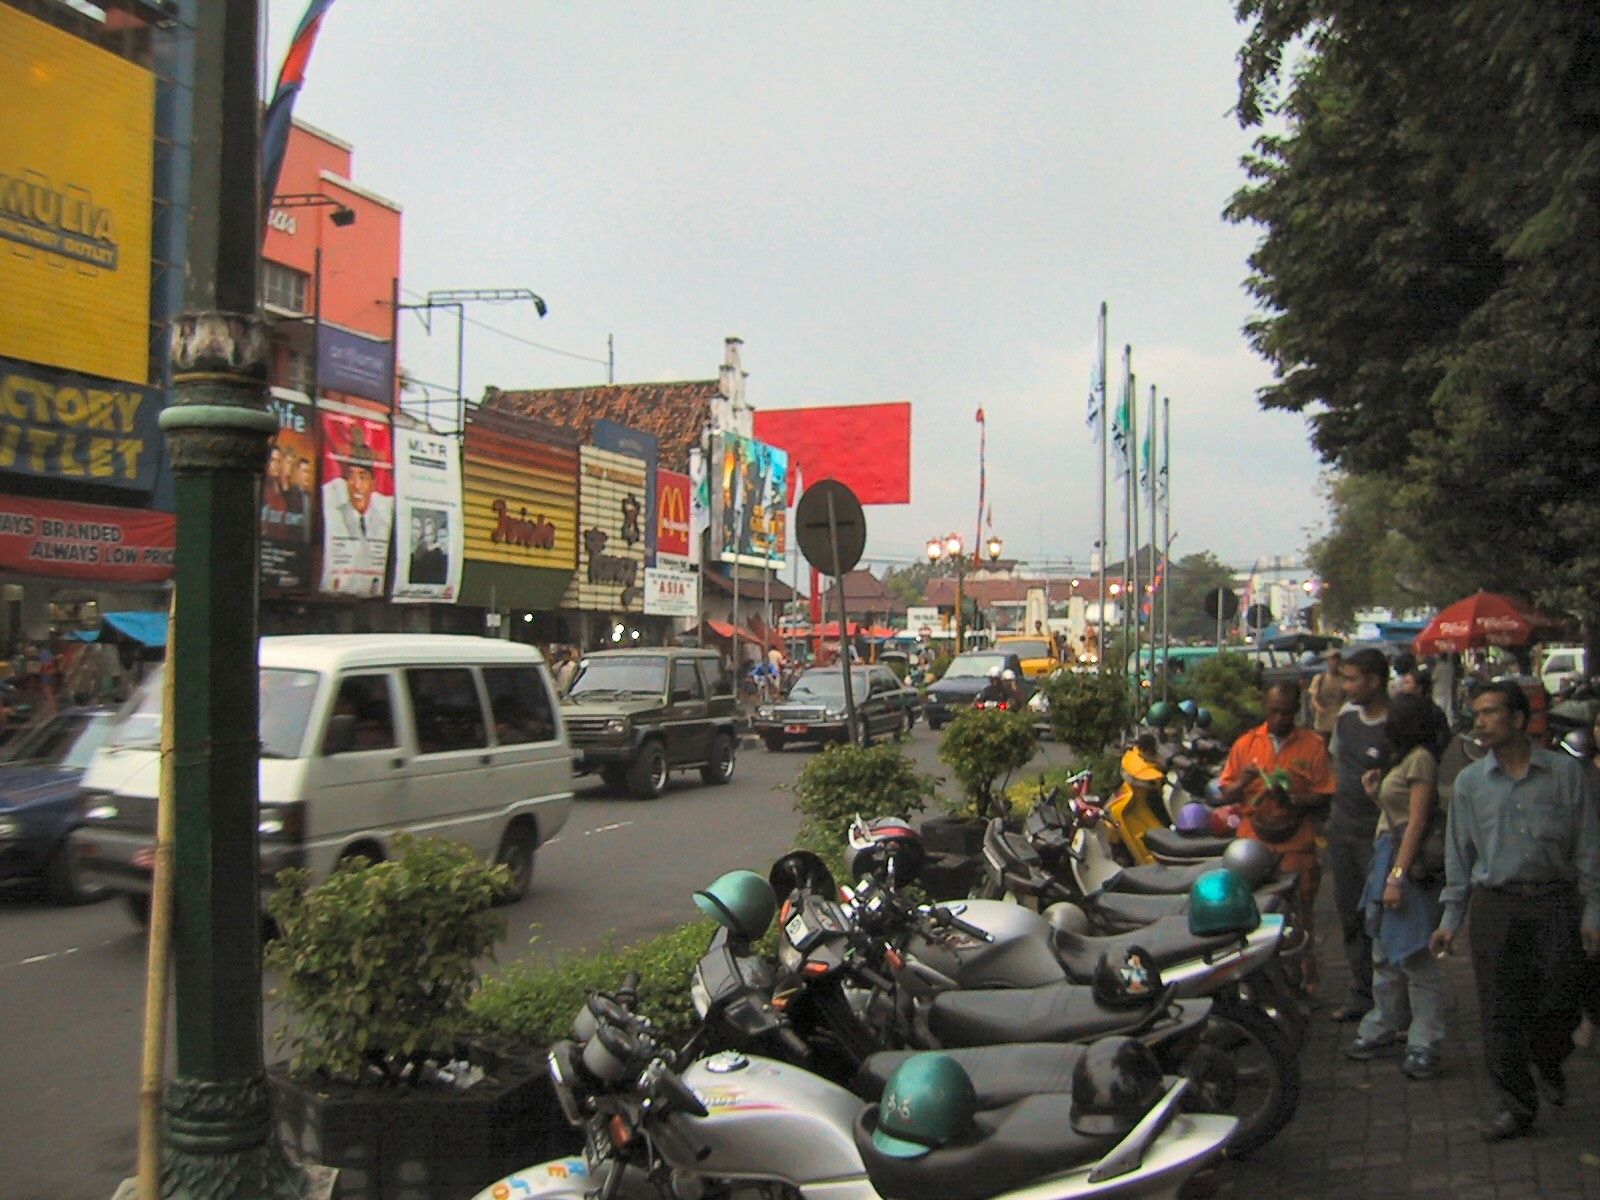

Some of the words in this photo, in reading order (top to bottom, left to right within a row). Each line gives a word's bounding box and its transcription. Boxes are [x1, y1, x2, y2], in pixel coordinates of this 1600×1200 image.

[0, 375, 143, 432] CTORY
[42, 518, 122, 544] BRANDED
[31, 540, 98, 565] ALWAYS
[105, 546, 137, 564] LOW
